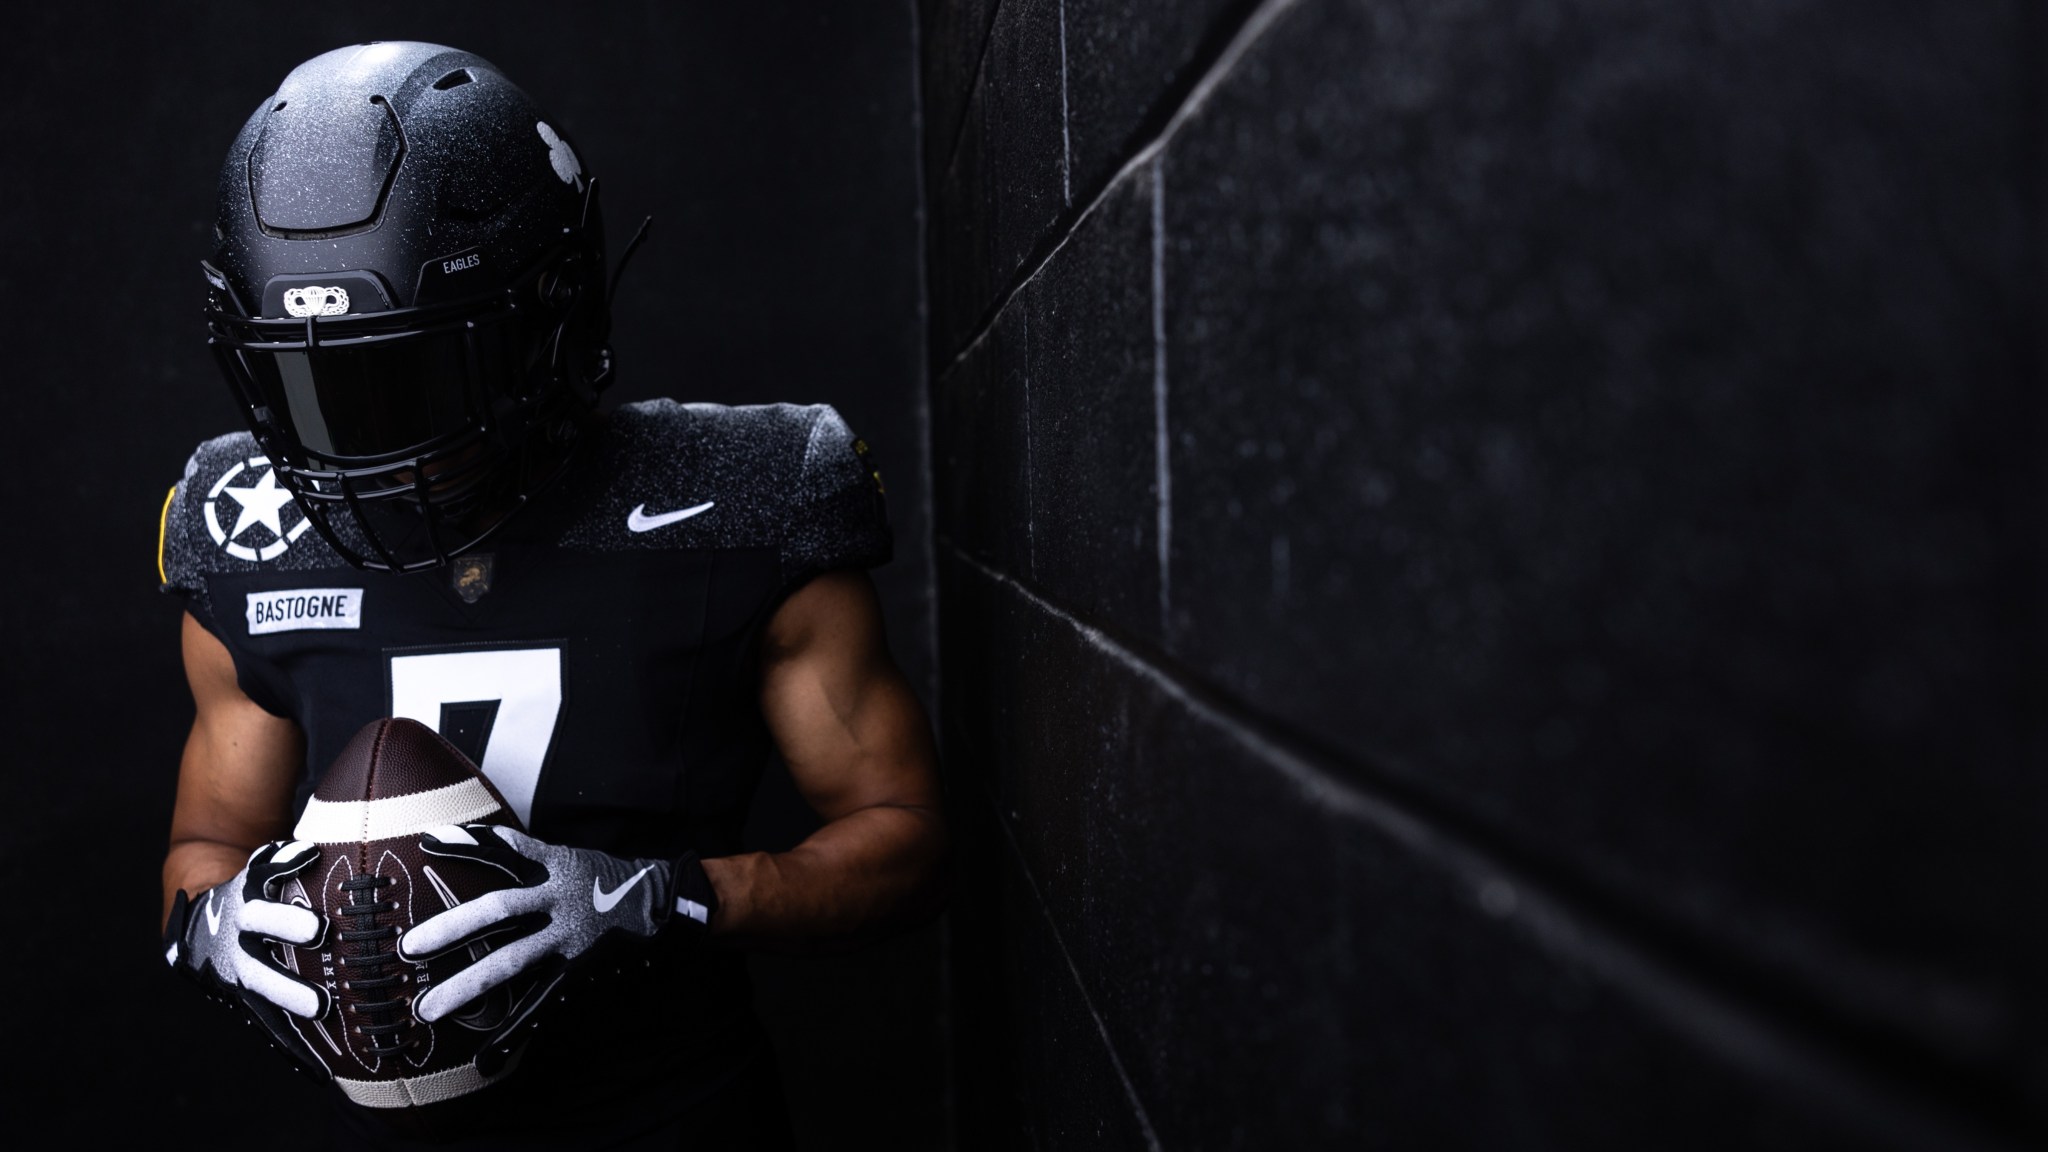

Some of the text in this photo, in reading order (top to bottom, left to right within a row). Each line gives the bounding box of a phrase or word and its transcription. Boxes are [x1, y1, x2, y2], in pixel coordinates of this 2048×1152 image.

[443, 253, 480, 274] EAGLES
[256, 595, 347, 624] BASTOGNE
[391, 647, 562, 834] 7
[321, 943, 340, 999] RMY!
